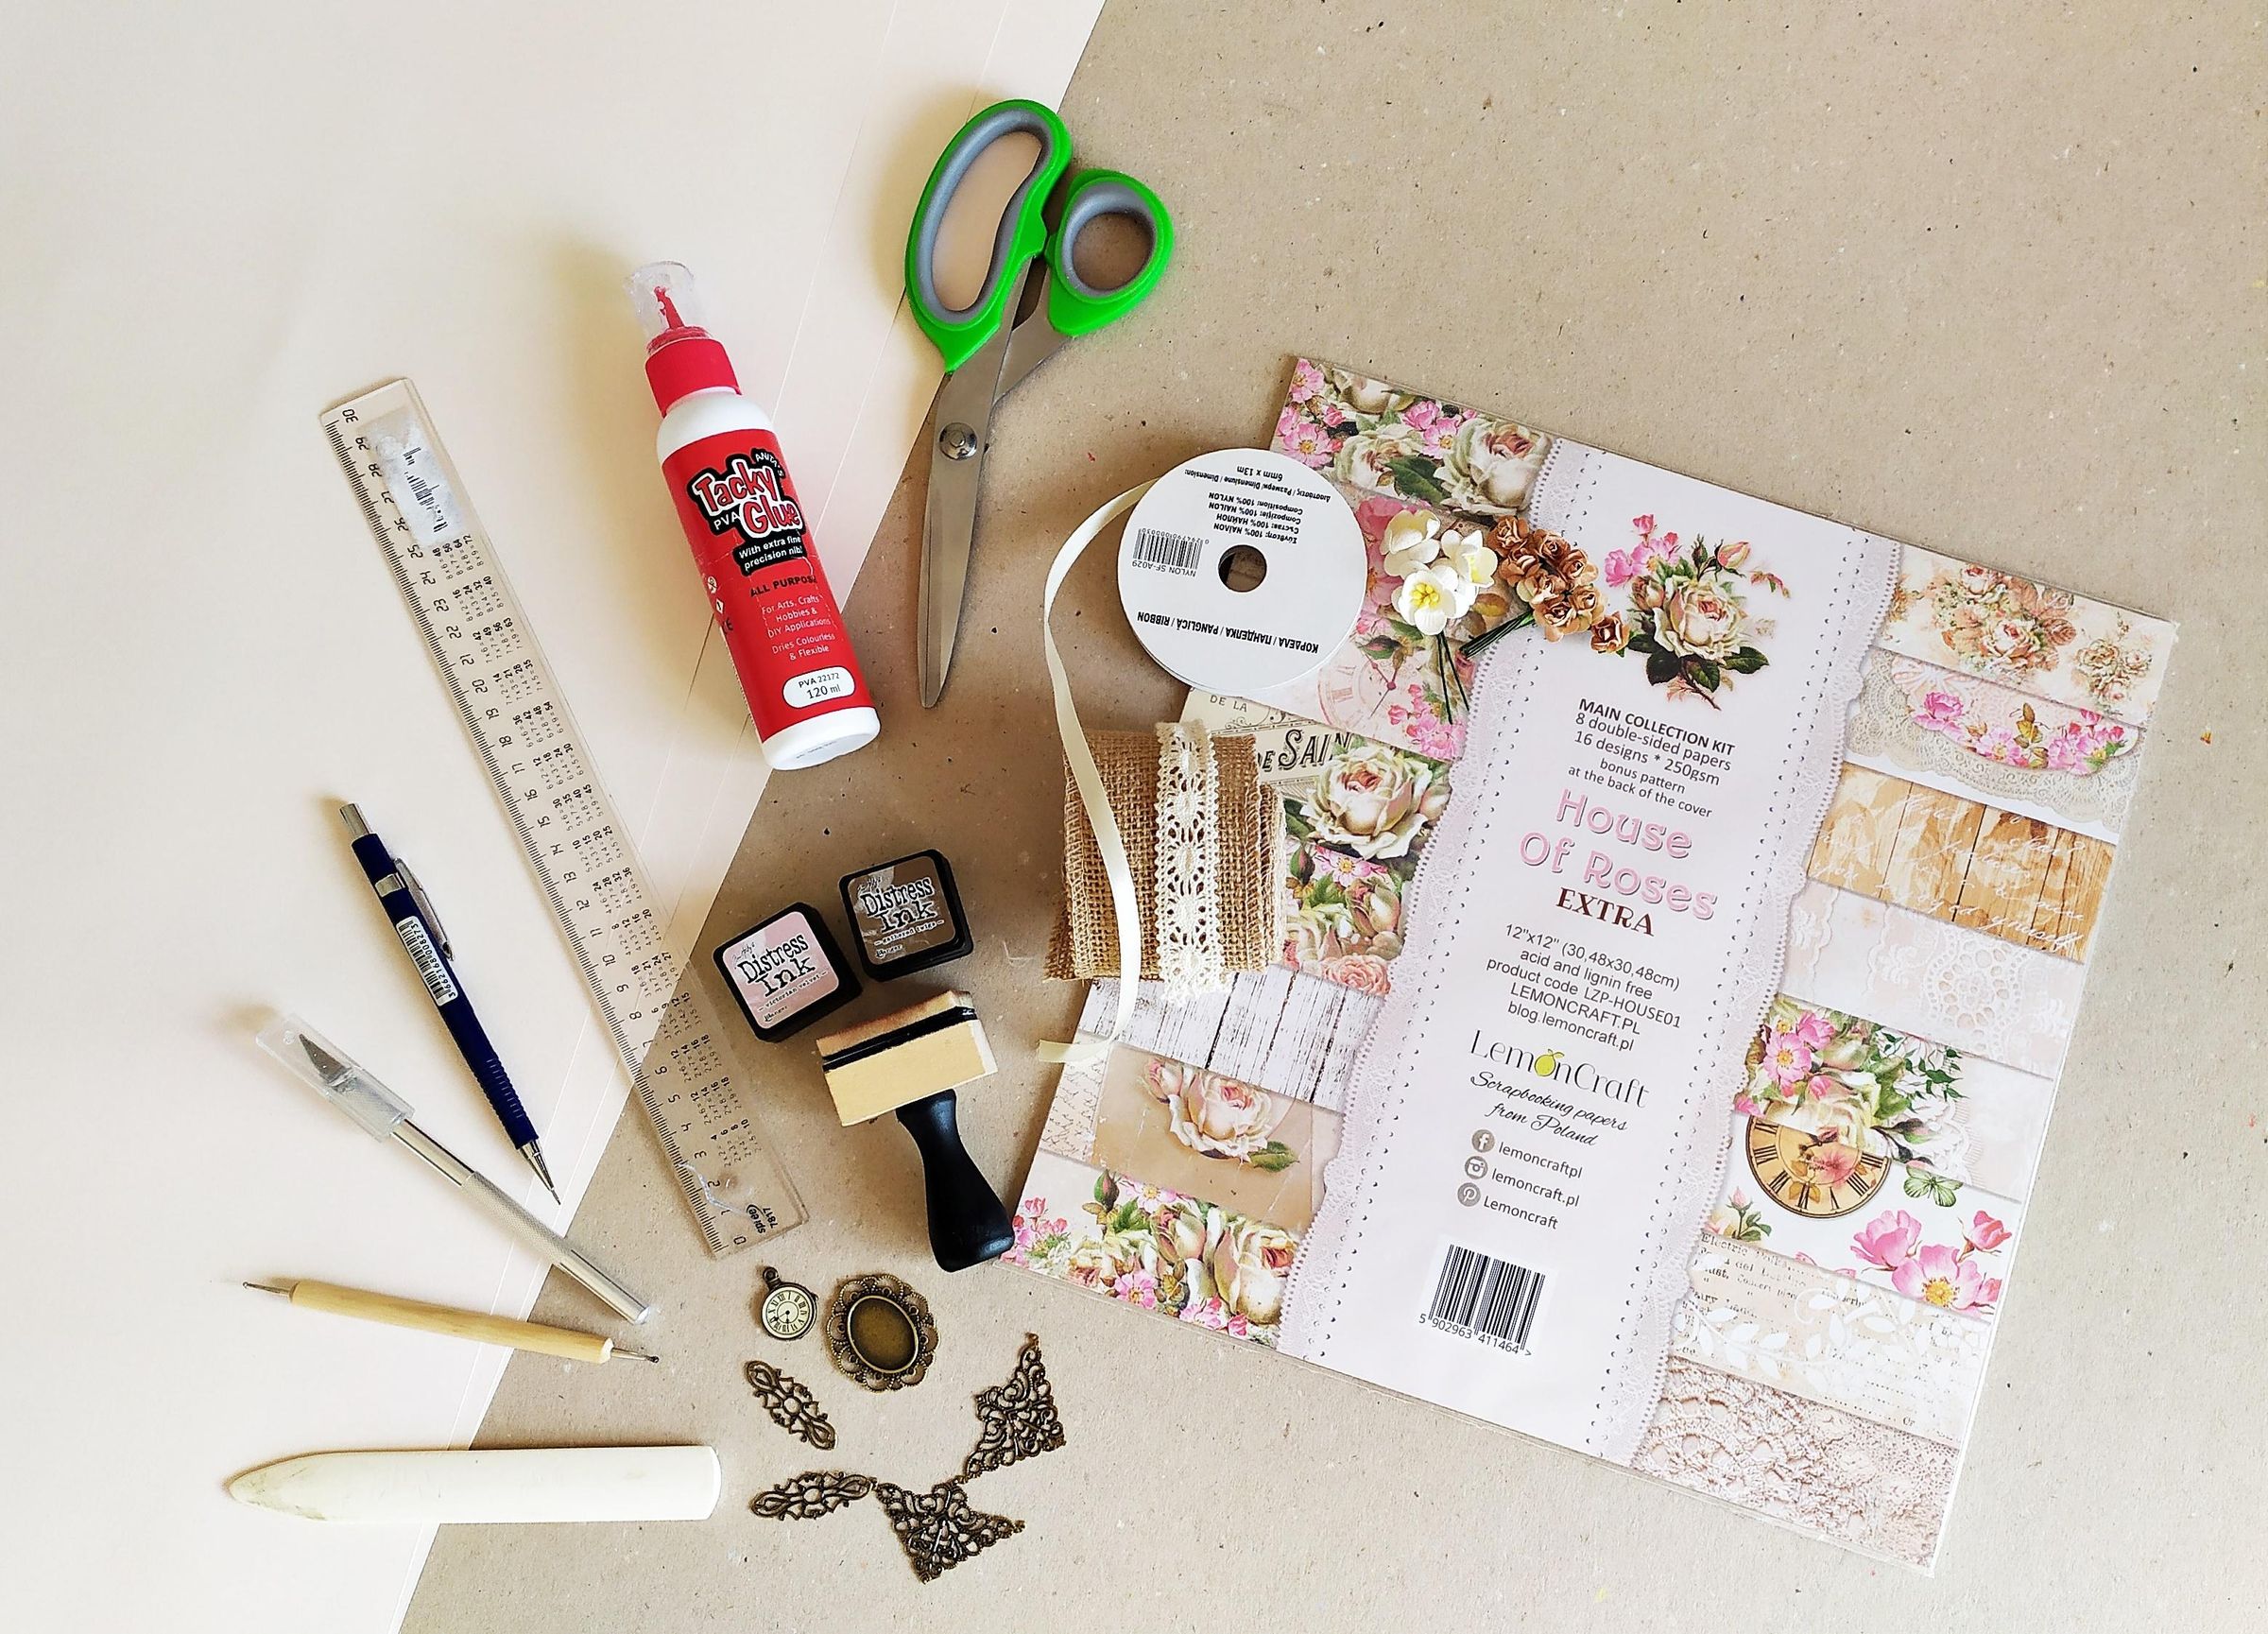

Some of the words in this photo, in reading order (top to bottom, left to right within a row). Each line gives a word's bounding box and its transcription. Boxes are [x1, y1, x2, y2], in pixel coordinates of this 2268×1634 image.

[342, 408, 358, 423] 30
[1236, 466, 1254, 476] 13m
[1263, 471, 1283, 482] 6mm
[694, 460, 779, 514] Tacky
[1223, 475, 1261, 490] Dimensiune
[1208, 491, 1235, 503] NYLON
[1236, 496, 1255, 507] 100%
[713, 511, 743, 530] PVA
[741, 494, 801, 536] Glue
[1238, 507, 1258, 517] 100%
[1257, 500, 1303, 516] Composition:
[1249, 519, 1269, 529] 100%
[1245, 527, 1263, 539] 100%
[407, 544, 423, 559] 25
[738, 544, 762, 559] With
[763, 539, 786, 550] extra
[786, 535, 801, 545] fine
[744, 549, 787, 572] precision
[1131, 559, 1167, 573] SF-A029
[420, 570, 436, 585] 24
[1168, 566, 1196, 577] NYLON
[749, 584, 771, 598] ALL
[434, 598, 449, 612] 23
[762, 605, 776, 615] For
[798, 594, 819, 605] Crafts
[776, 610, 810, 622] Hobbies
[1137, 611, 1171, 627] RIBBON
[446, 625, 462, 639] 22
[767, 628, 782, 639] DIY
[783, 618, 831, 632] Applications
[772, 642, 795, 654] Dries
[796, 633, 835, 646] Colourless
[798, 645, 830, 658] Flexible
[459, 653, 474, 666] 21
[472, 679, 488, 694] 20
[798, 678, 817, 689] PVA
[818, 672, 840, 683] 22172
[806, 685, 829, 699] 120
[829, 683, 841, 694] ml
[1210, 694, 1227, 707] DE
[1232, 700, 1247, 713] LA
[486, 708, 500, 720] 19
[1579, 698, 1622, 721] MAIN
[1624, 713, 1710, 748] COLLECTION
[1711, 740, 1736, 756] KIT
[499, 735, 513, 748] 18
[1575, 713, 1586, 725] 8
[1588, 717, 1681, 755] double-sided
[1682, 748, 1731, 771] papers
[1574, 731, 1593, 746] 16
[1595, 737, 1649, 764] designs
[1663, 758, 1720, 786] 250gsm
[511, 762, 525, 774] 17
[1599, 758, 1638, 780] bonus
[1640, 773, 1686, 794] pattern
[524, 789, 538, 801] 16
[1568, 766, 1581, 778] at
[1584, 769, 1605, 785] the
[1606, 776, 1636, 795] back
[1639, 788, 1654, 799] of
[1655, 791, 1675, 807] the
[1677, 800, 1712, 817] cover
[538, 816, 551, 828] 15
[1556, 788, 1692, 859] House
[550, 843, 564, 855] 14
[563, 870, 577, 884] 13
[1520, 832, 1575, 874] Of
[1583, 850, 1717, 920] Roses
[576, 899, 591, 911] 12
[859, 877, 935, 918] Distress
[875, 899, 936, 933] Ink
[1555, 886, 1654, 937] EXTRA
[590, 927, 603, 937] 11
[882, 929, 915, 943] gathered
[915, 921, 937, 934] twigs
[602, 954, 616, 967] 10
[736, 934, 810, 985] Distress
[1561, 942, 1680, 991] (30,48x30,48cm)
[754, 956, 816, 998] Ink
[1520, 950, 1551, 968] acid
[1553, 960, 1580, 977] and
[1583, 967, 1622, 990] lignin
[1624, 981, 1653, 1000] free
[765, 988, 798, 1006] victorian
[799, 974, 821, 989] velvet
[1486, 958, 1541, 984] product
[1543, 977, 1579, 995] code
[1584, 987, 1680, 1028] LZP-HOUSE01
[629, 1011, 643, 1021] 8
[1510, 982, 1641, 1035] LEMONCRAFT.PL
[1507, 1001, 1635, 1052] blog.lemoncraft.pl
[1469, 1029, 1650, 1109] LemonCraft
[667, 1093, 681, 1103] 5
[1469, 1071, 1574, 1116] Scrapbooking
[1572, 1109, 1627, 1131] papers
[680, 1122, 692, 1132] 4
[1485, 1102, 1527, 1124] from
[1530, 1114, 1599, 1145] Poland
[695, 1150, 707, 1160] 3
[1498, 1141, 1583, 1178] lemoncraftpl
[1491, 1168, 1580, 1207] lemoncraft.pl
[762, 1207, 779, 1229] 7817
[1483, 1195, 1558, 1230] Lemoncraft
[1432, 1317, 1473, 1339] 902963
[1477, 1333, 1520, 1354] 411464
